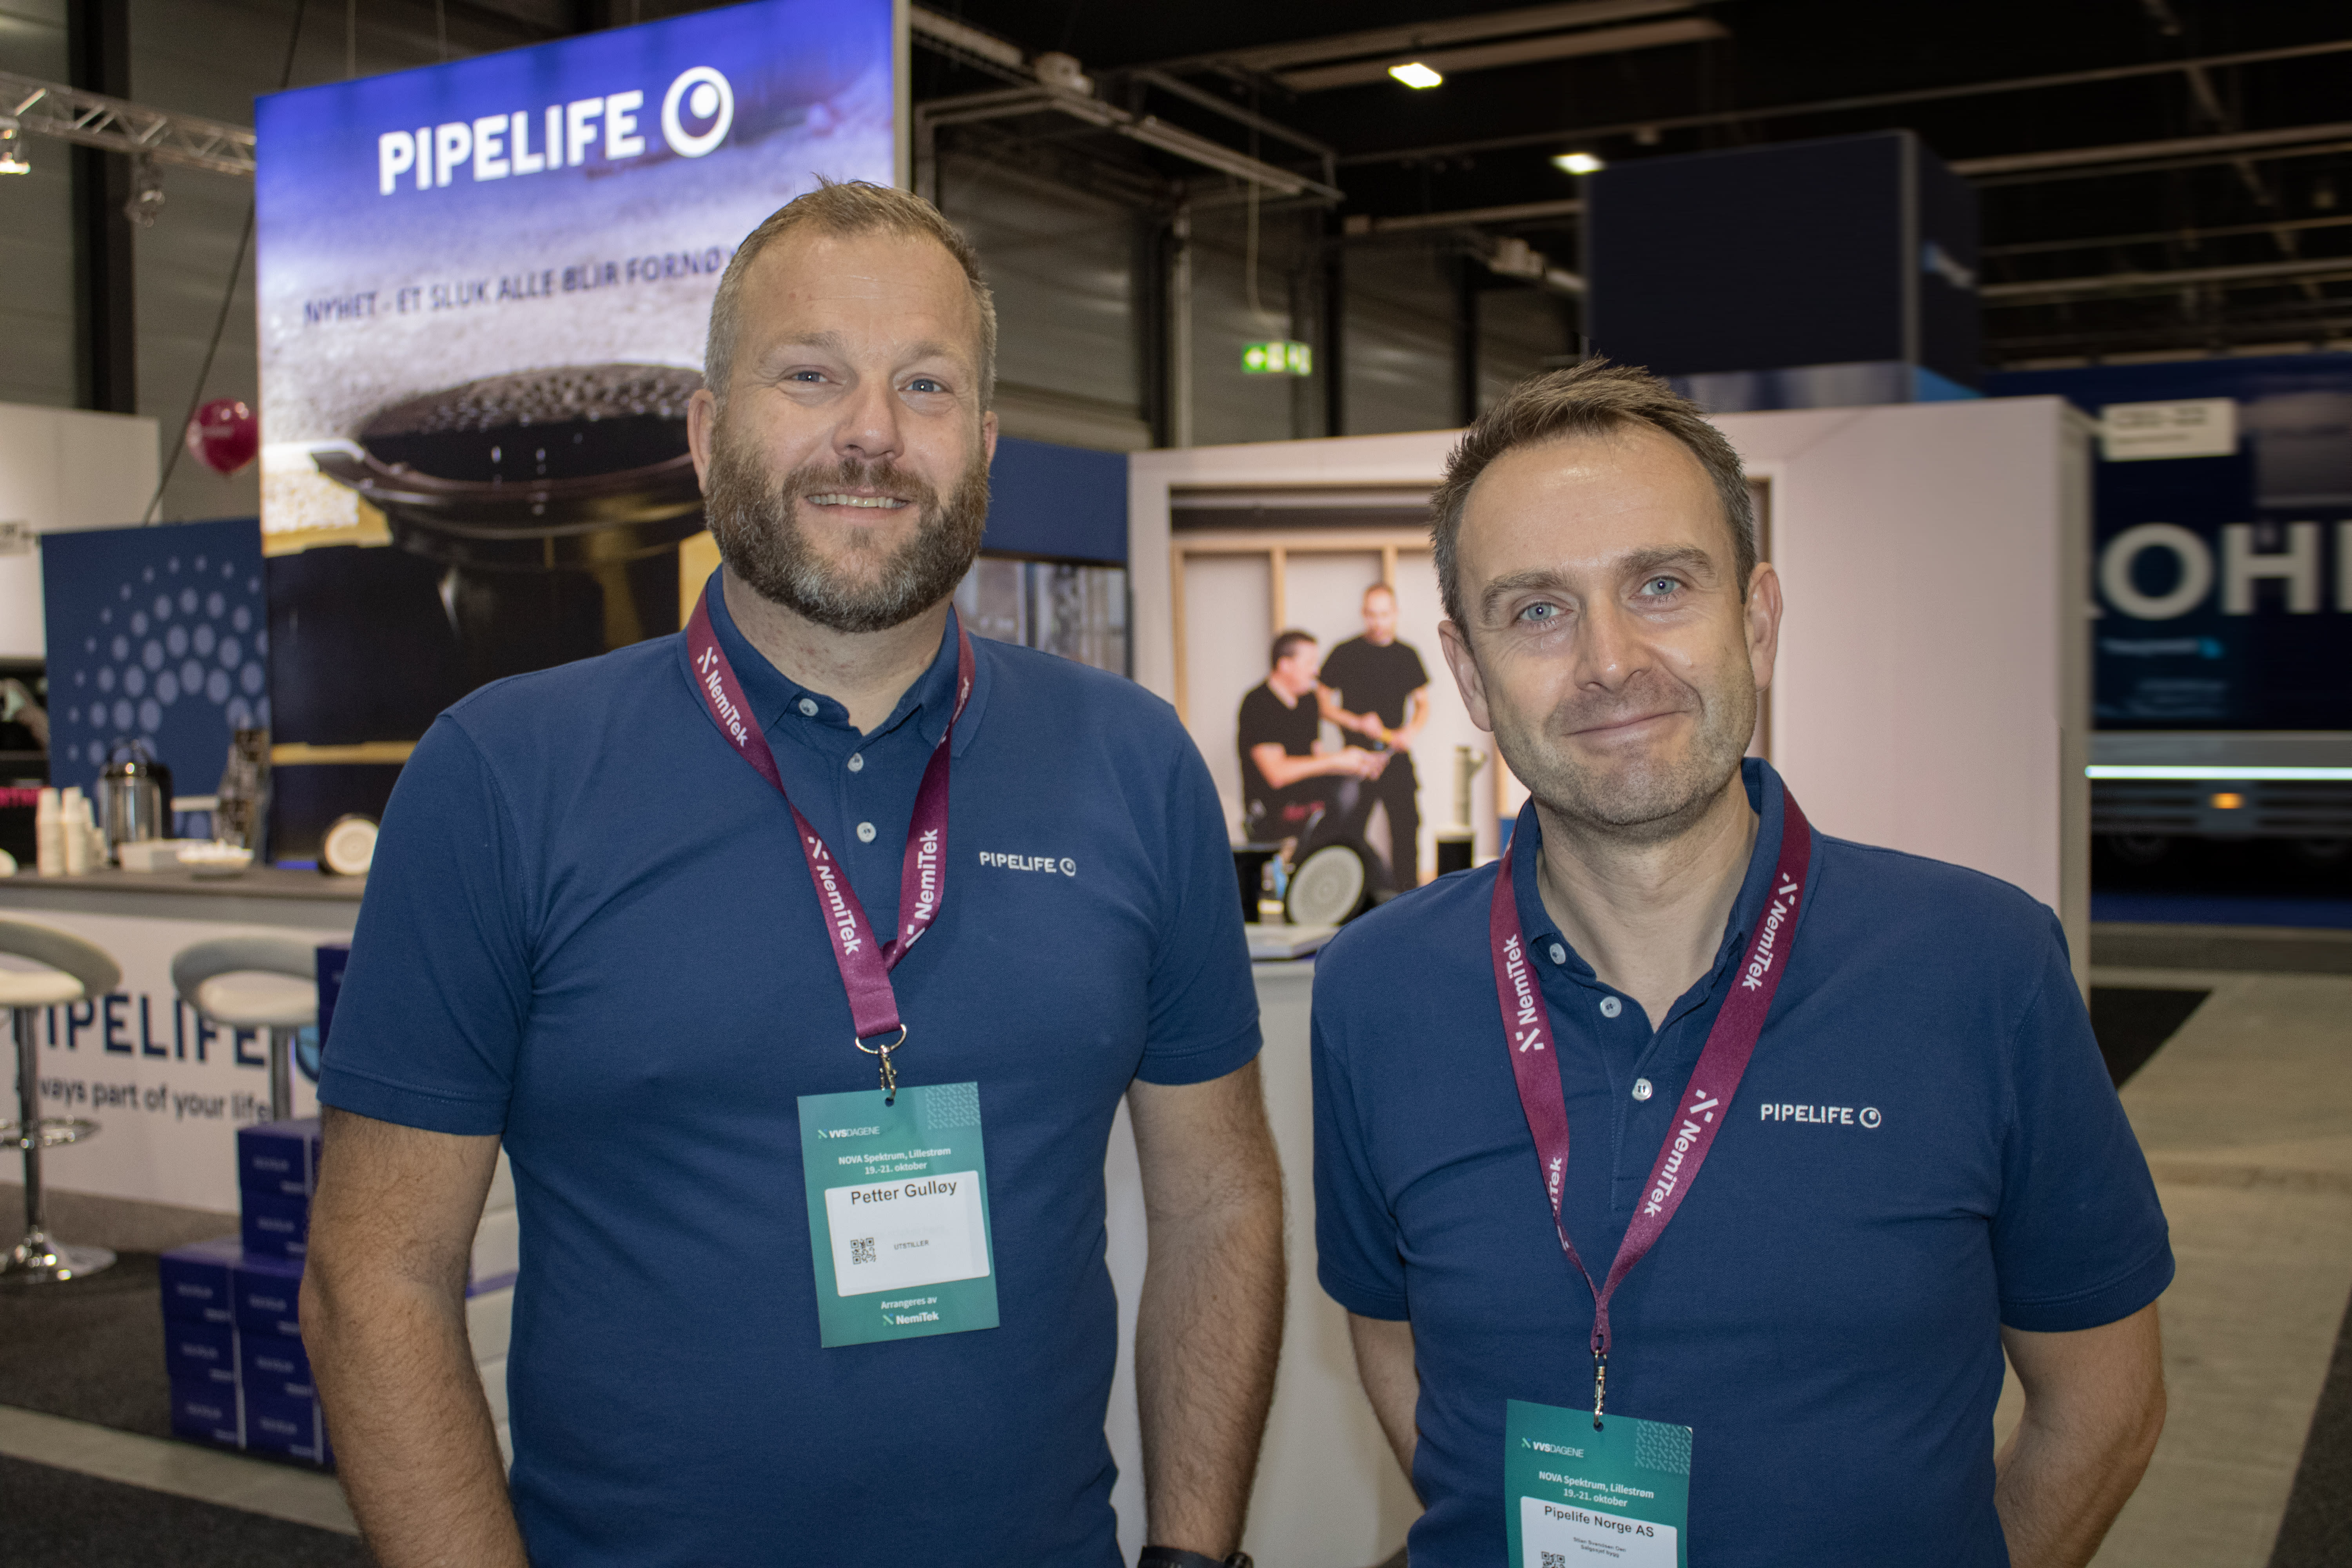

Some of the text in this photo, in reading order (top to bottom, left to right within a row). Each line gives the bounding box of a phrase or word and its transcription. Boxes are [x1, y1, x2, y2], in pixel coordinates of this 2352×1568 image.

[379, 90, 645, 196] PIPELIFE
[303, 292, 379, 325] NYHET
[396, 285, 423, 314] ET
[429, 276, 489, 311] SLUK
[496, 269, 551, 303] ALLE
[561, 258, 620, 292] BLIR
[626, 245, 735, 285] FORNØ
[705, 669, 748, 747] NemiTek
[914, 828, 938, 920] NemiTek
[979, 851, 1057, 873] PIPELIFE
[816, 865, 862, 956] NemiTek
[1742, 900, 1788, 991] NemiTek
[1503, 934, 1538, 1025] NemiTek
[14, 992, 265, 1066] IPELIFE
[93, 1080, 138, 1113] part
[143, 1085, 168, 1111] of
[172, 1095, 225, 1122] your
[1760, 1103, 1854, 1125] PIPELIFE
[829, 1126, 880, 1138] VVSDAGENE
[838, 1147, 951, 1165] NOVA Spektrum, Lillestrøm
[865, 1162, 927, 1175] 19.-21. oktober
[1644, 1119, 1701, 1217] NemiTek
[851, 1180, 957, 1205] Petter Gulløy
[893, 1239, 929, 1250] UTSTILLER
[880, 1297, 926, 1310] Arrangeres
[895, 1312, 939, 1325] NemiTek
[1533, 1441, 1584, 1458] VVSDAGENE
[1539, 1471, 1654, 1499] NOVA Spektrum, Lillestrøm
[1563, 1488, 1628, 1507] 19.-21. oktober
[1544, 1505, 1654, 1537] Pipelife Norge AS
